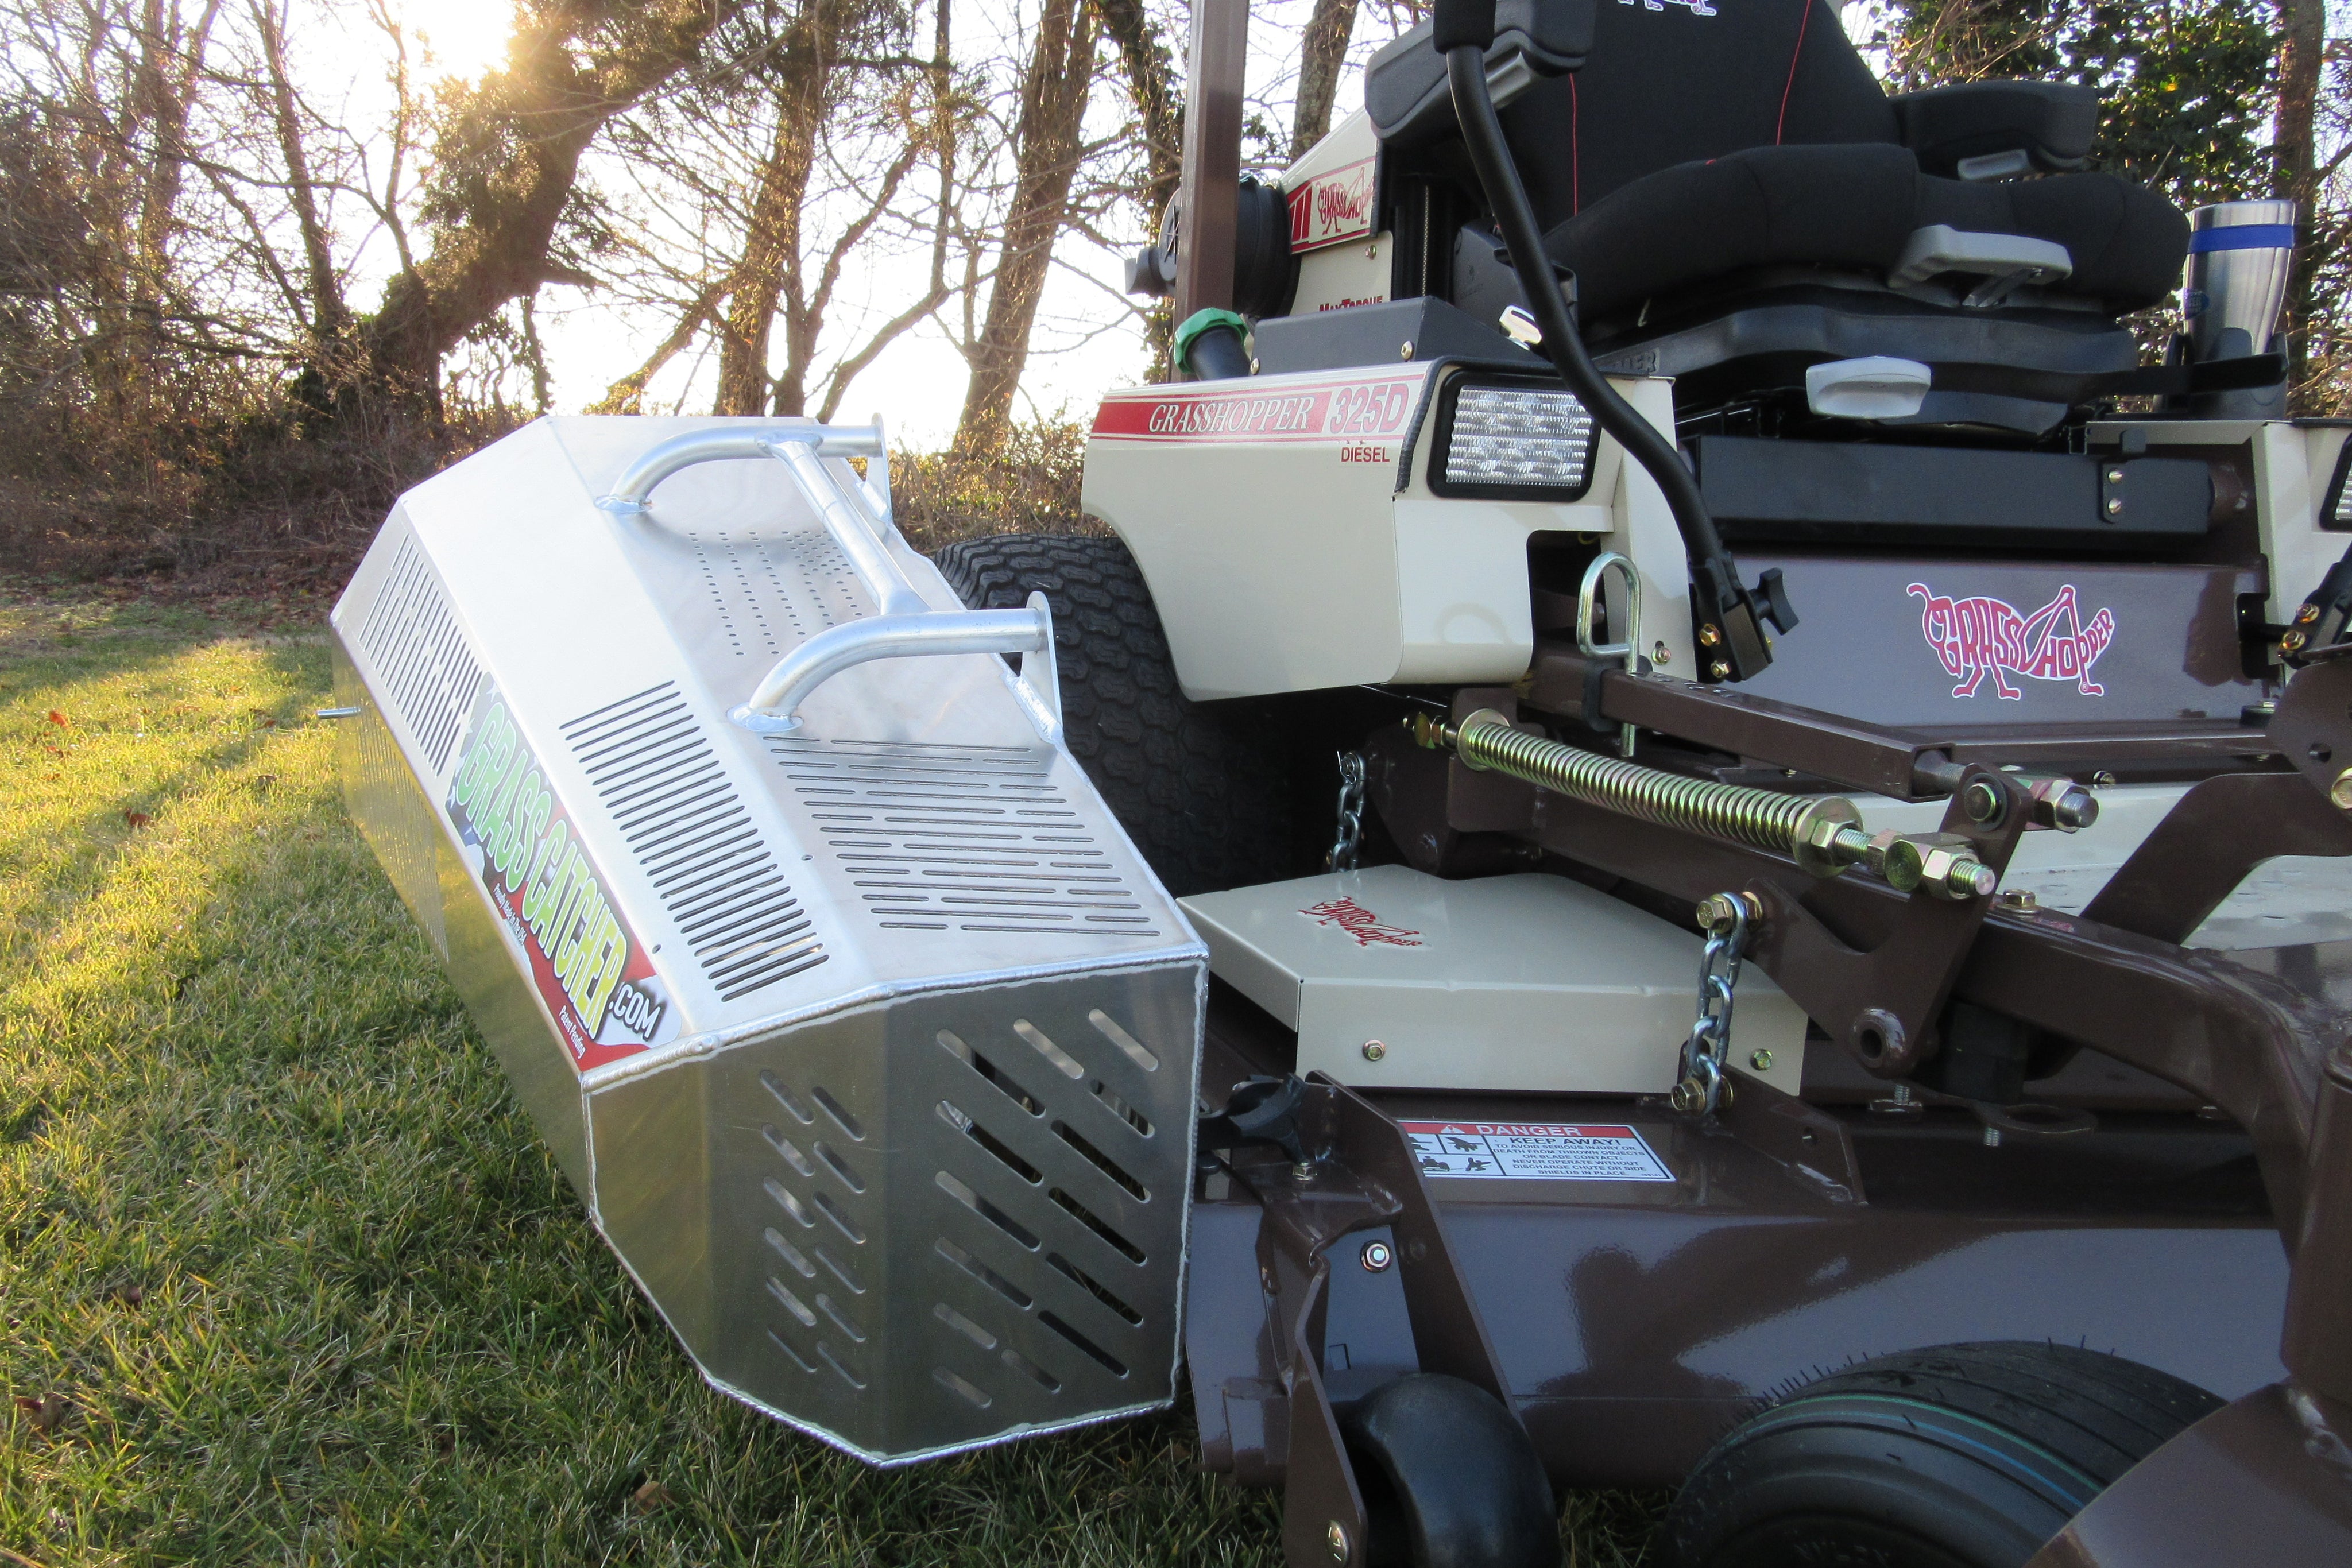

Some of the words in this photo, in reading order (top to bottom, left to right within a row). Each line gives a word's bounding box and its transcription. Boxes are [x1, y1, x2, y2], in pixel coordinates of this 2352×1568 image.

[1148, 396, 1314, 433] GRASSHOPPER
[1330, 383, 1409, 433] 325D
[1341, 447, 1390, 463] DIESEL
[493, 882, 506, 908] Proudly
[502, 900, 513, 920] Made
[517, 927, 527, 945] USA
[559, 1005, 573, 1033] Patent
[570, 1024, 586, 1059] Pending
[1476, 1125, 1583, 1136] DANGER
